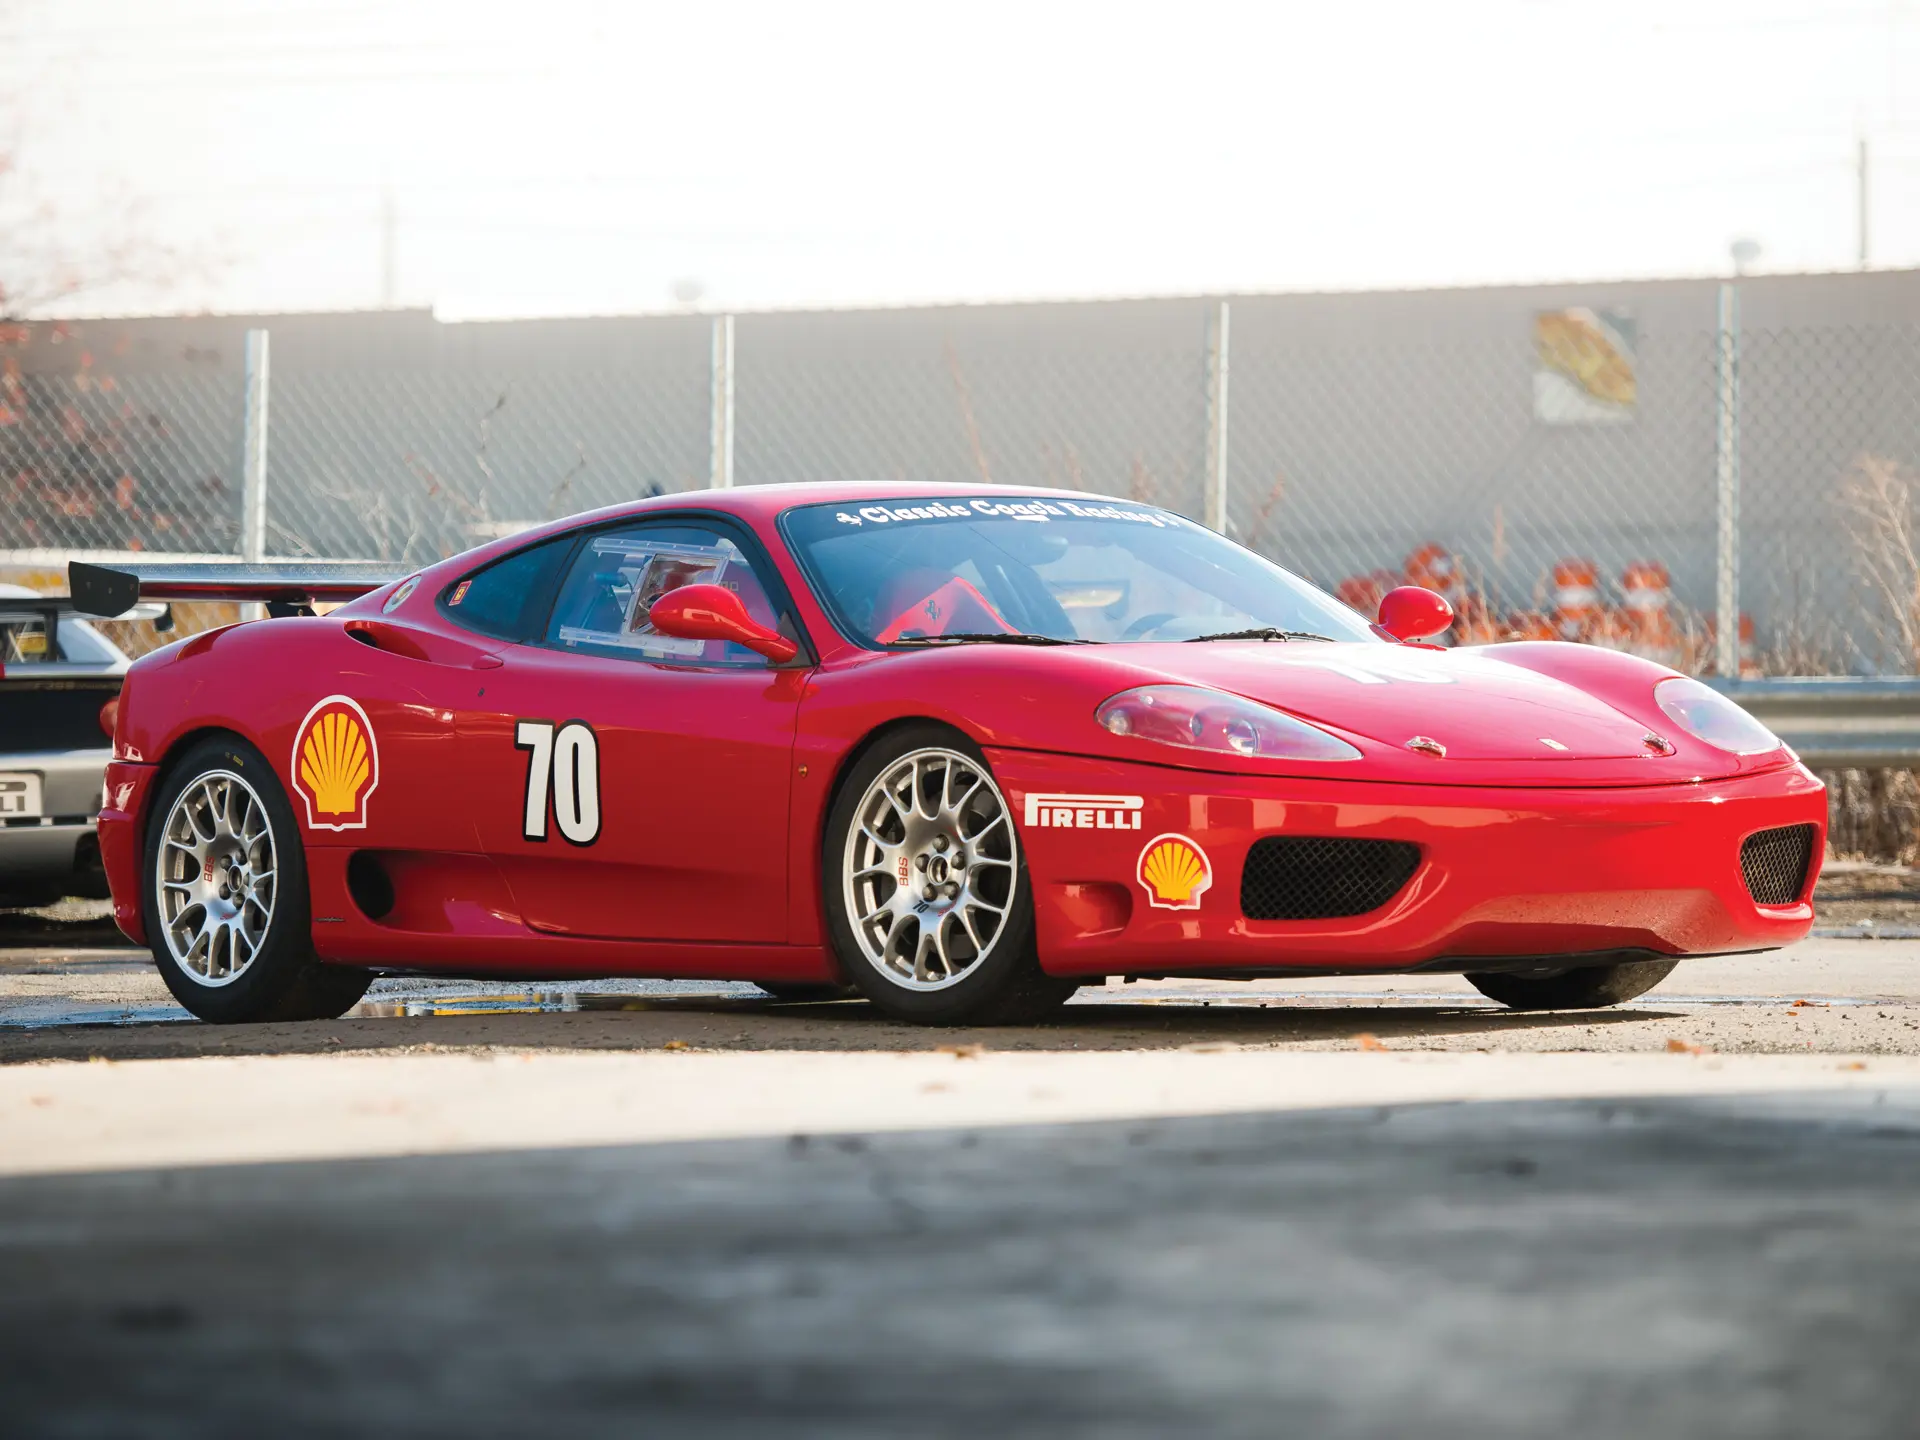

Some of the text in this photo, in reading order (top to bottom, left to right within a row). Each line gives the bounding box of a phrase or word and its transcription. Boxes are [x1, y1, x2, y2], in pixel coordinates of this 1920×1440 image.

[859, 500, 1165, 528] Classic Coach Racing
[515, 719, 602, 847] 70
[1025, 793, 1144, 830] PIRELLI
[204, 855, 215, 882] BBS
[898, 856, 909, 887] BBS
[912, 900, 929, 914] 70
